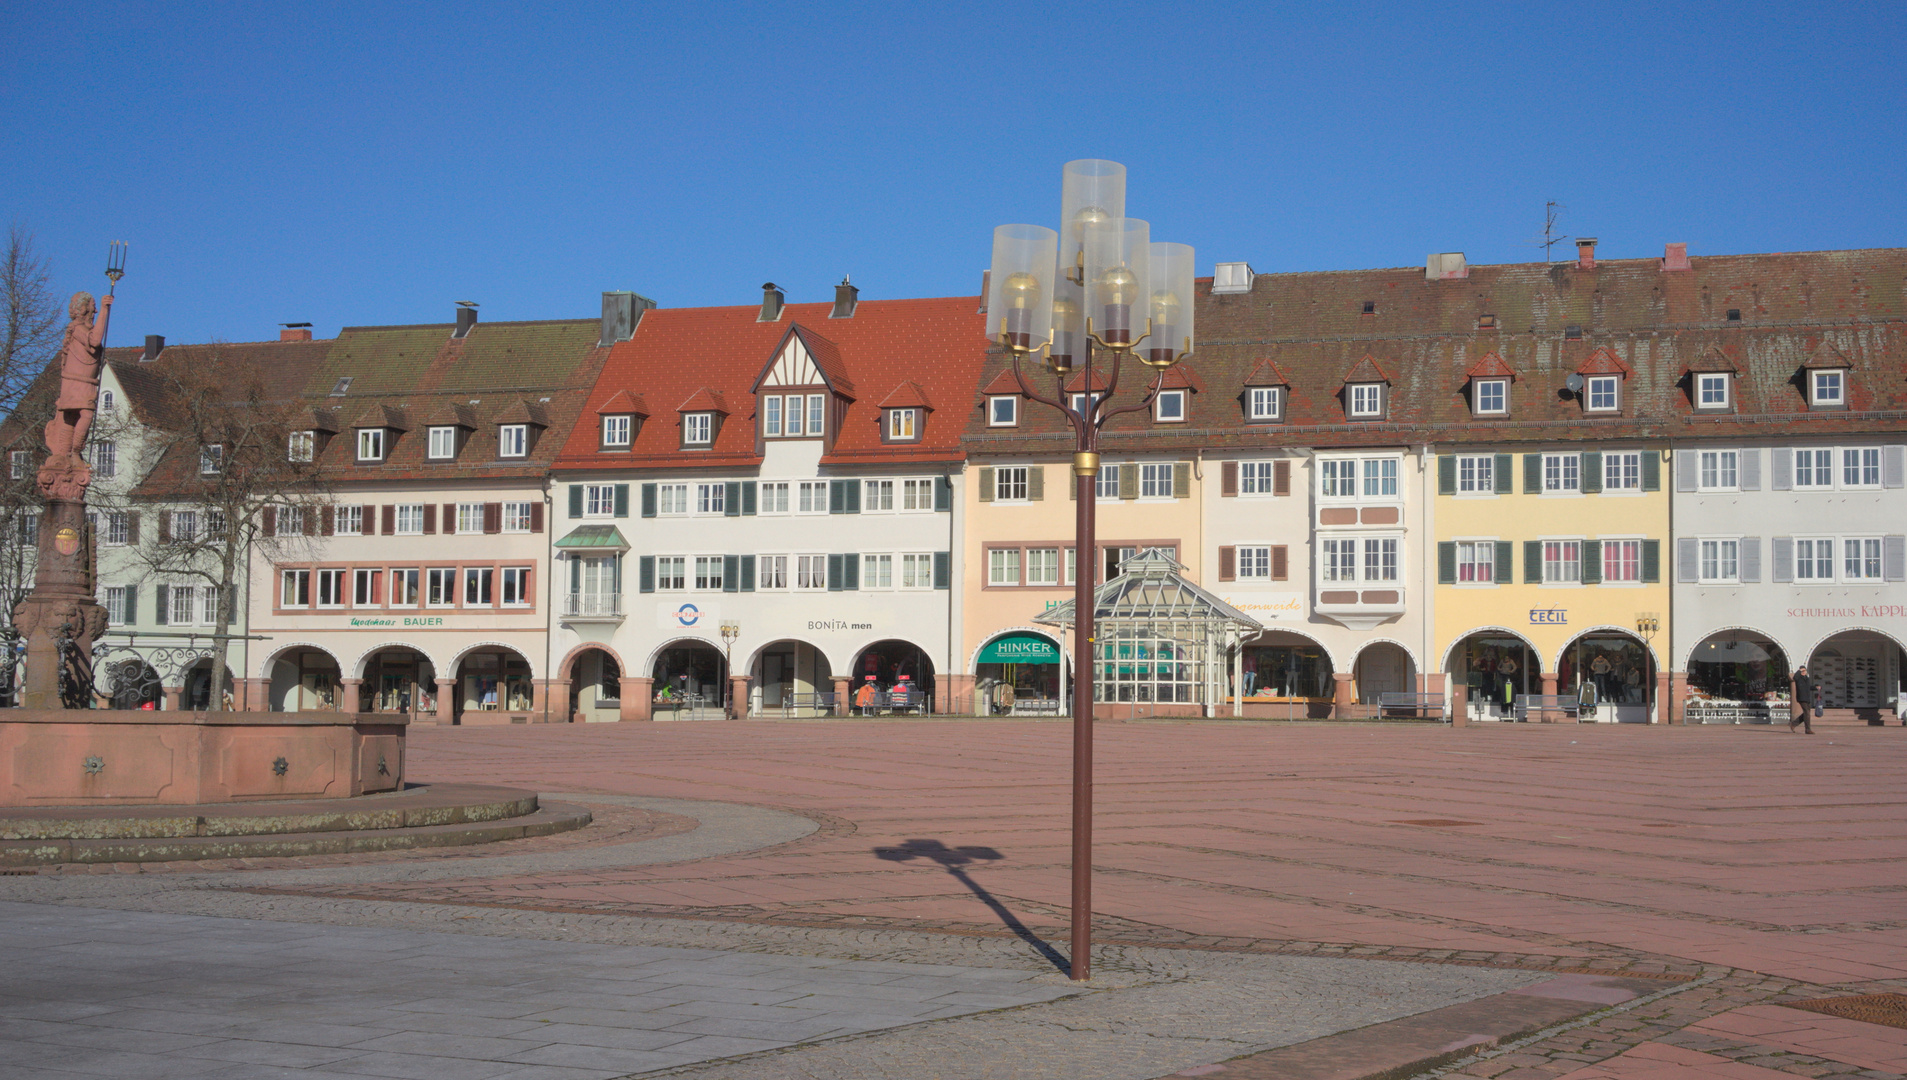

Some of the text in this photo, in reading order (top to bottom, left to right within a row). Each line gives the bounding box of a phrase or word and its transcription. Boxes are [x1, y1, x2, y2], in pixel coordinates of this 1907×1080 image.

[1787, 605, 1907, 617] SCHUHHAUS KAPPL
[403, 617, 443, 626] BAUER
[1529, 612, 1567, 622] CECIL
[998, 643, 1051, 653] HINKER
